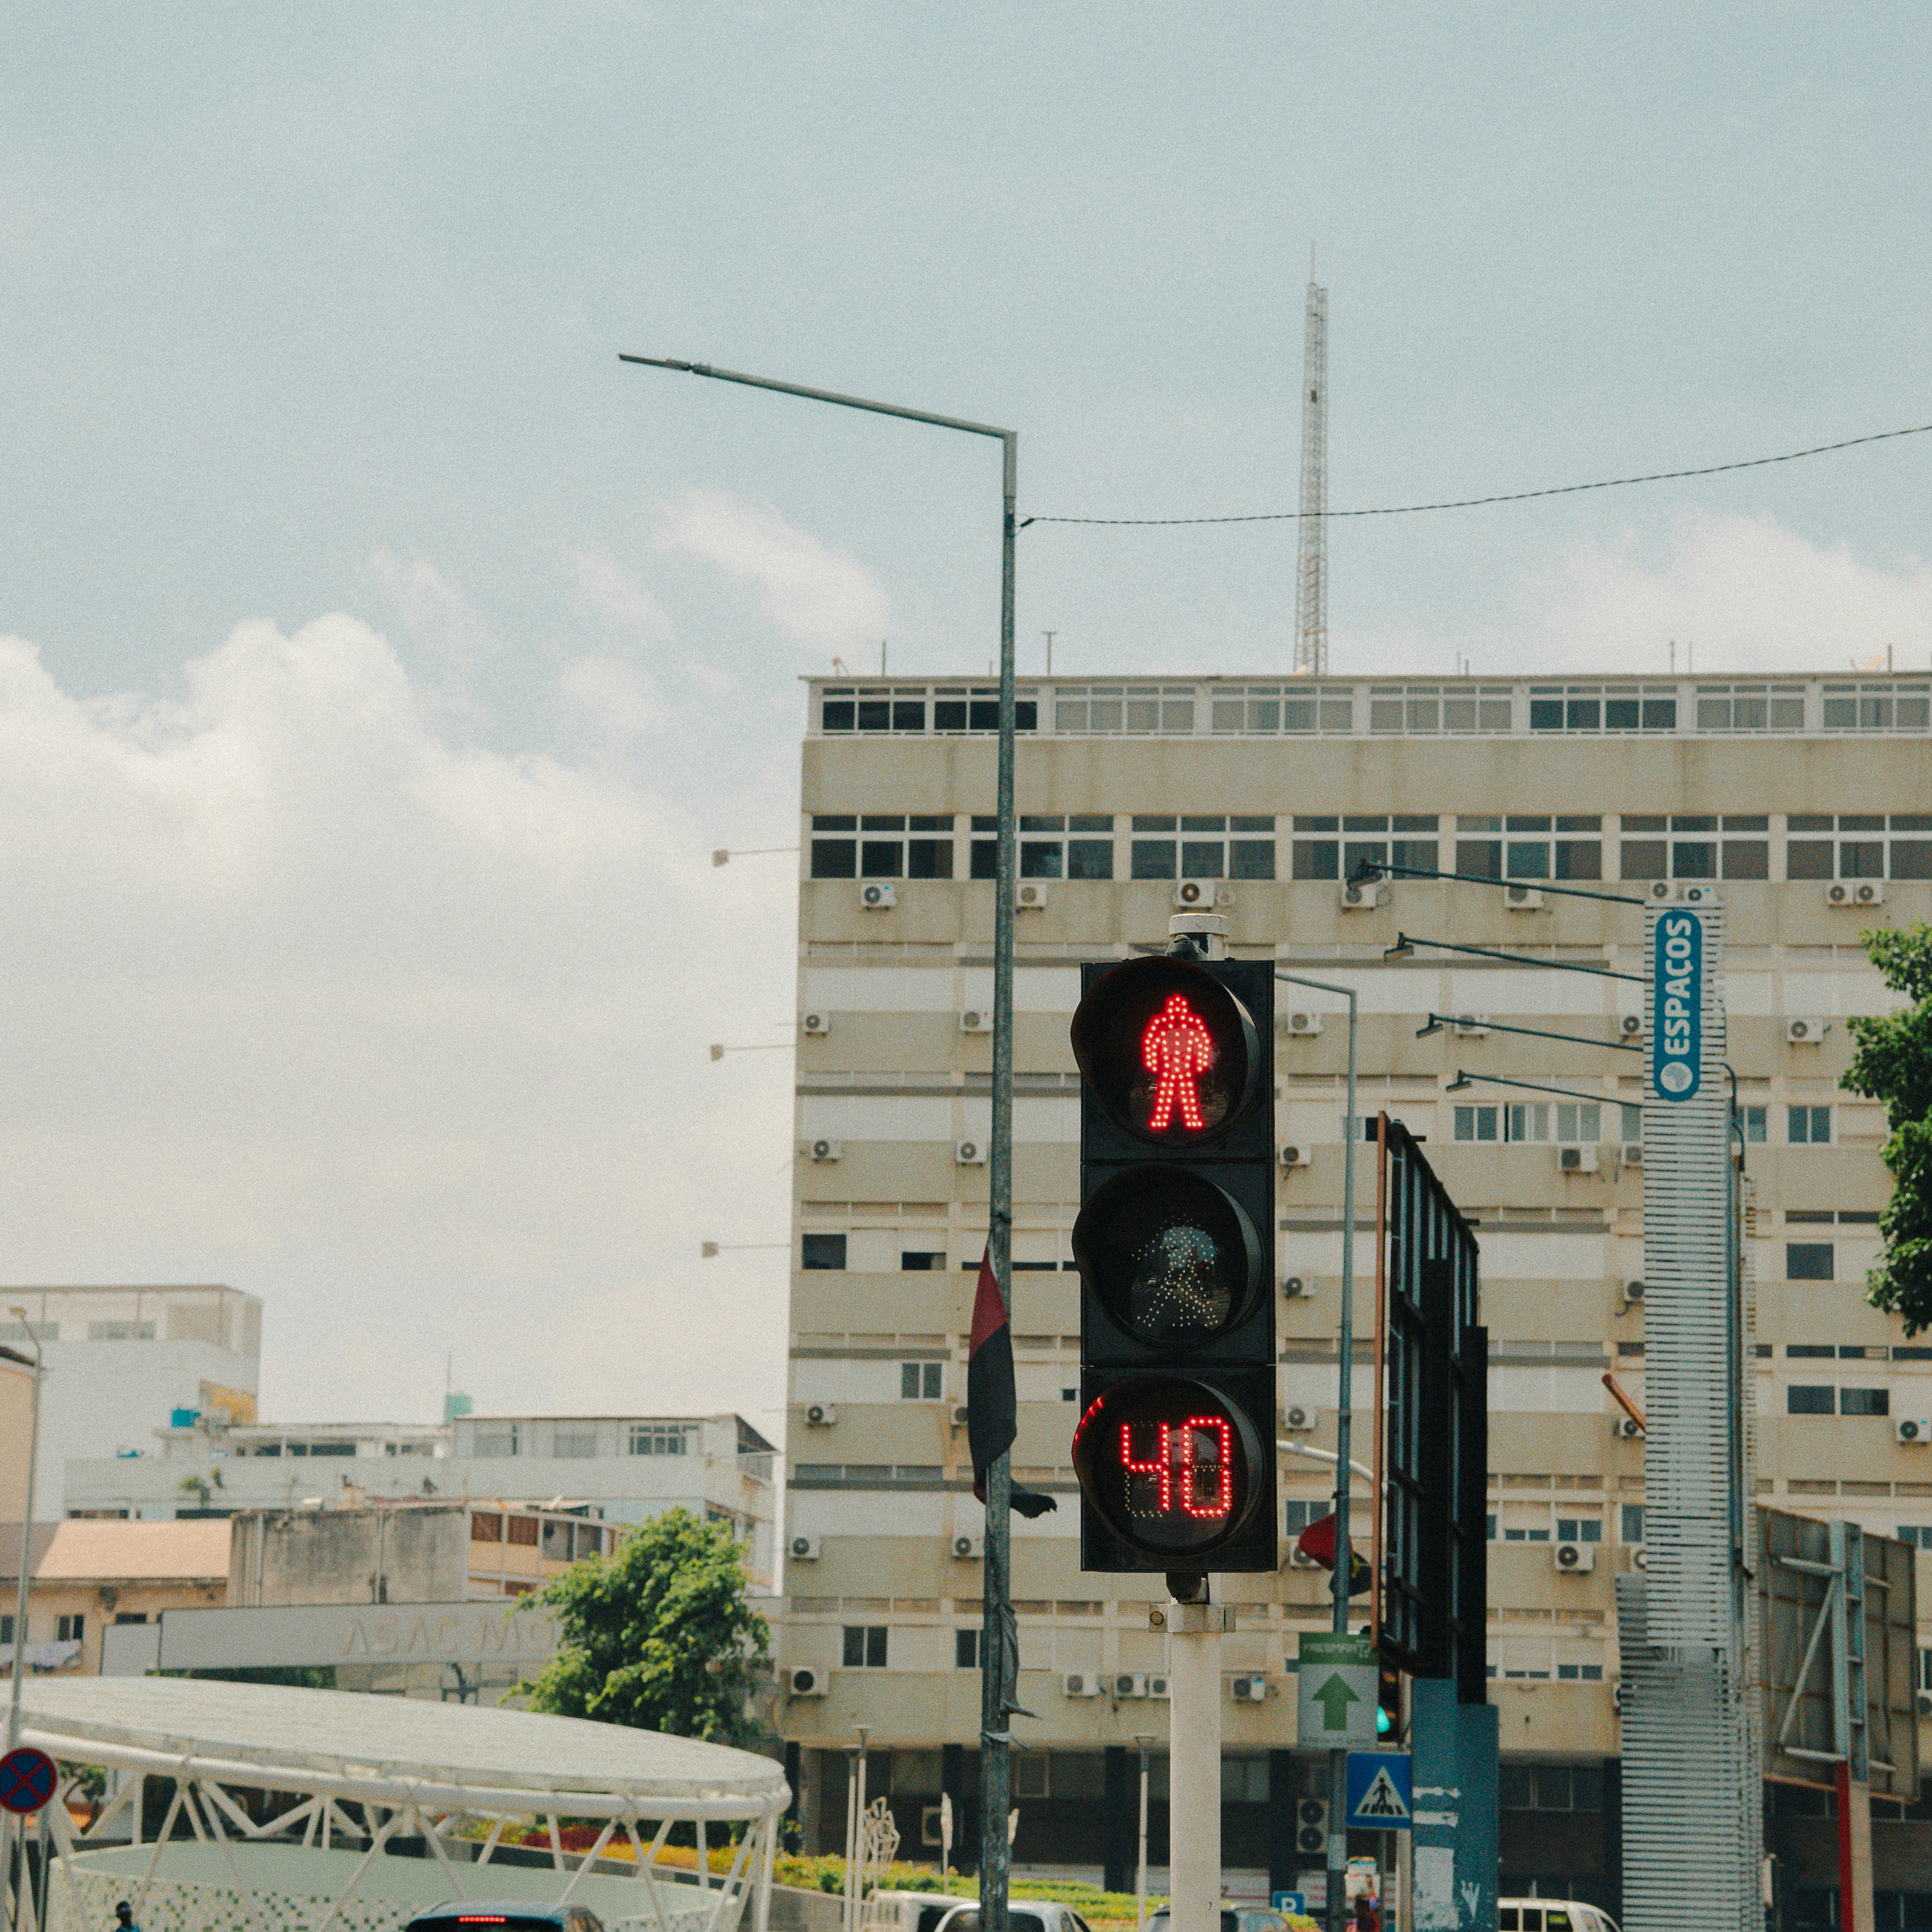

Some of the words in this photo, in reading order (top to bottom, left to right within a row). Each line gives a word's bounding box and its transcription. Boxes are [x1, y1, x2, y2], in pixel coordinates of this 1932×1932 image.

[1664, 918, 1693, 1056] ESPAÇOS
[1121, 1416, 1231, 1518] 40
[1281, 1897, 1297, 1913] P
